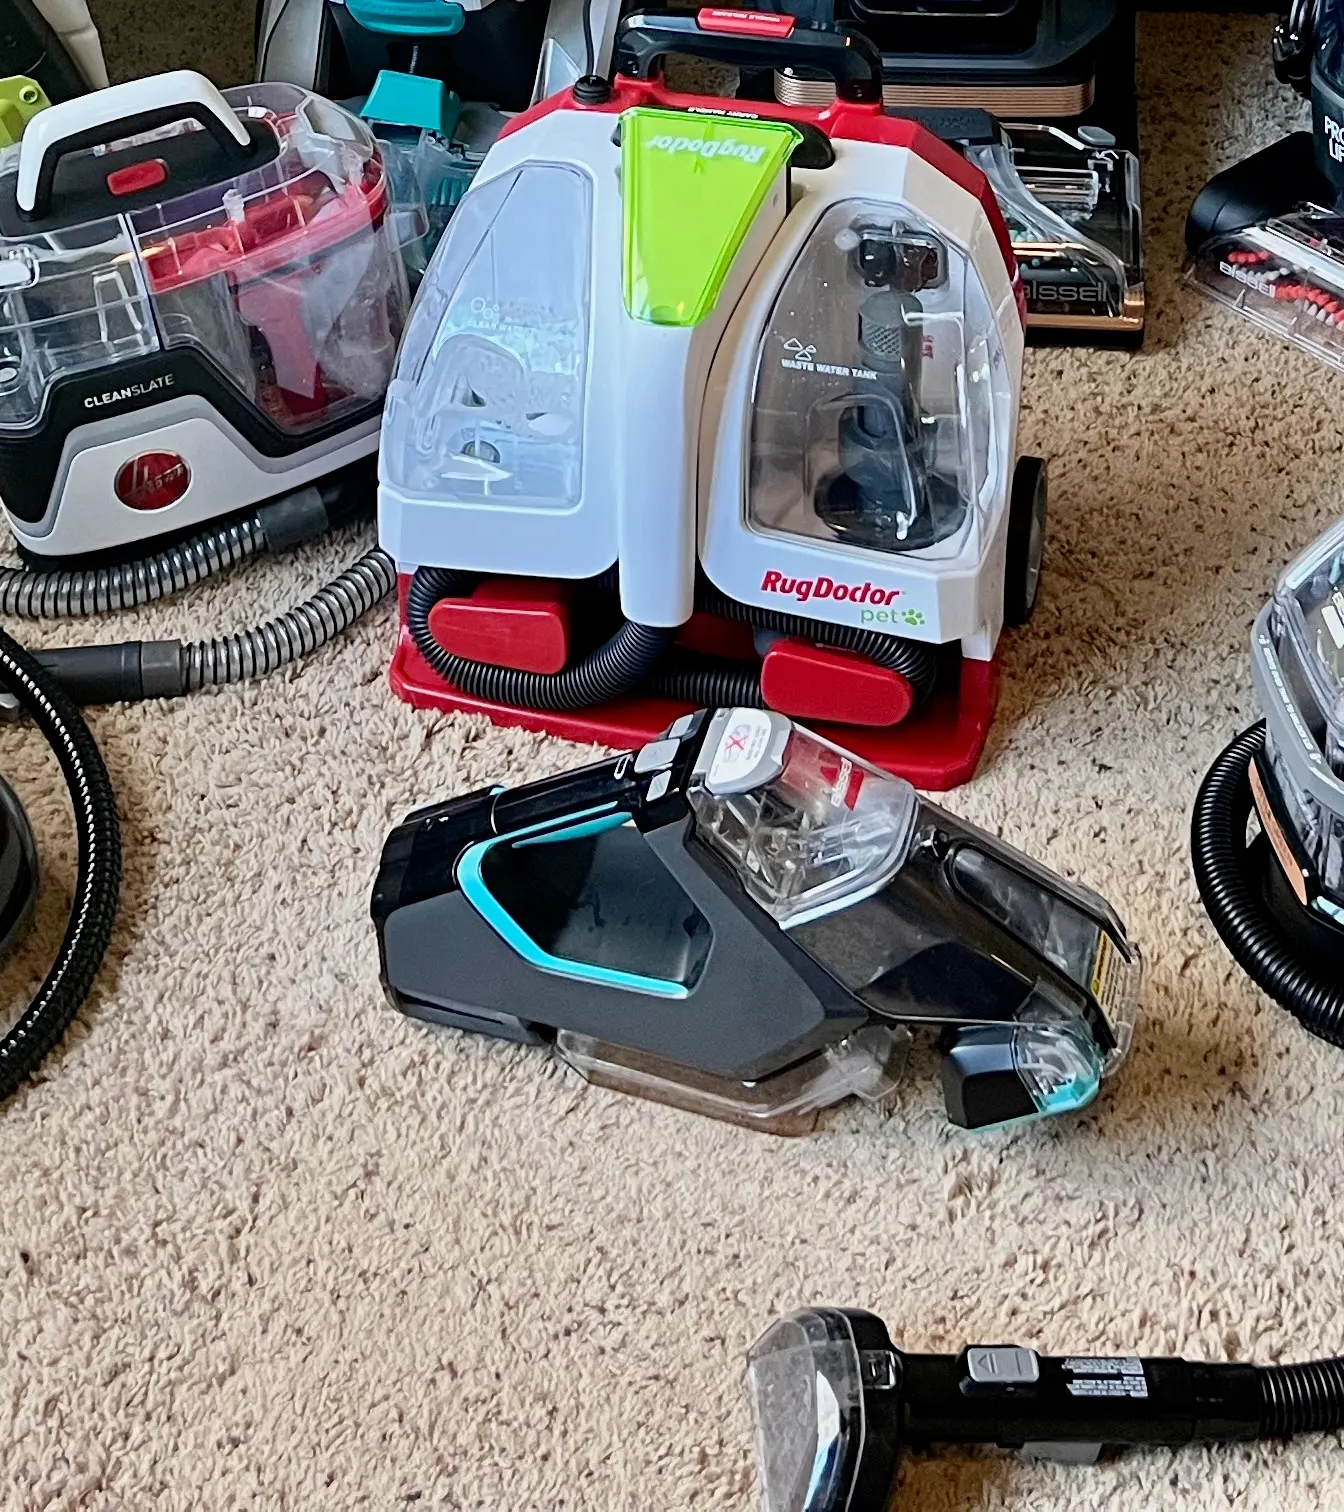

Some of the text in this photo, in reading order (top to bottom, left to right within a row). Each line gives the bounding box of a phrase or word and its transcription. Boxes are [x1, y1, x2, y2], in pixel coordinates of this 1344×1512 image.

[780, 357, 878, 381] WASTE WATER TANK
[83, 373, 176, 409] CLEANSLATE
[760, 569, 902, 606] RugDoctor
[860, 608, 899, 625] pet
